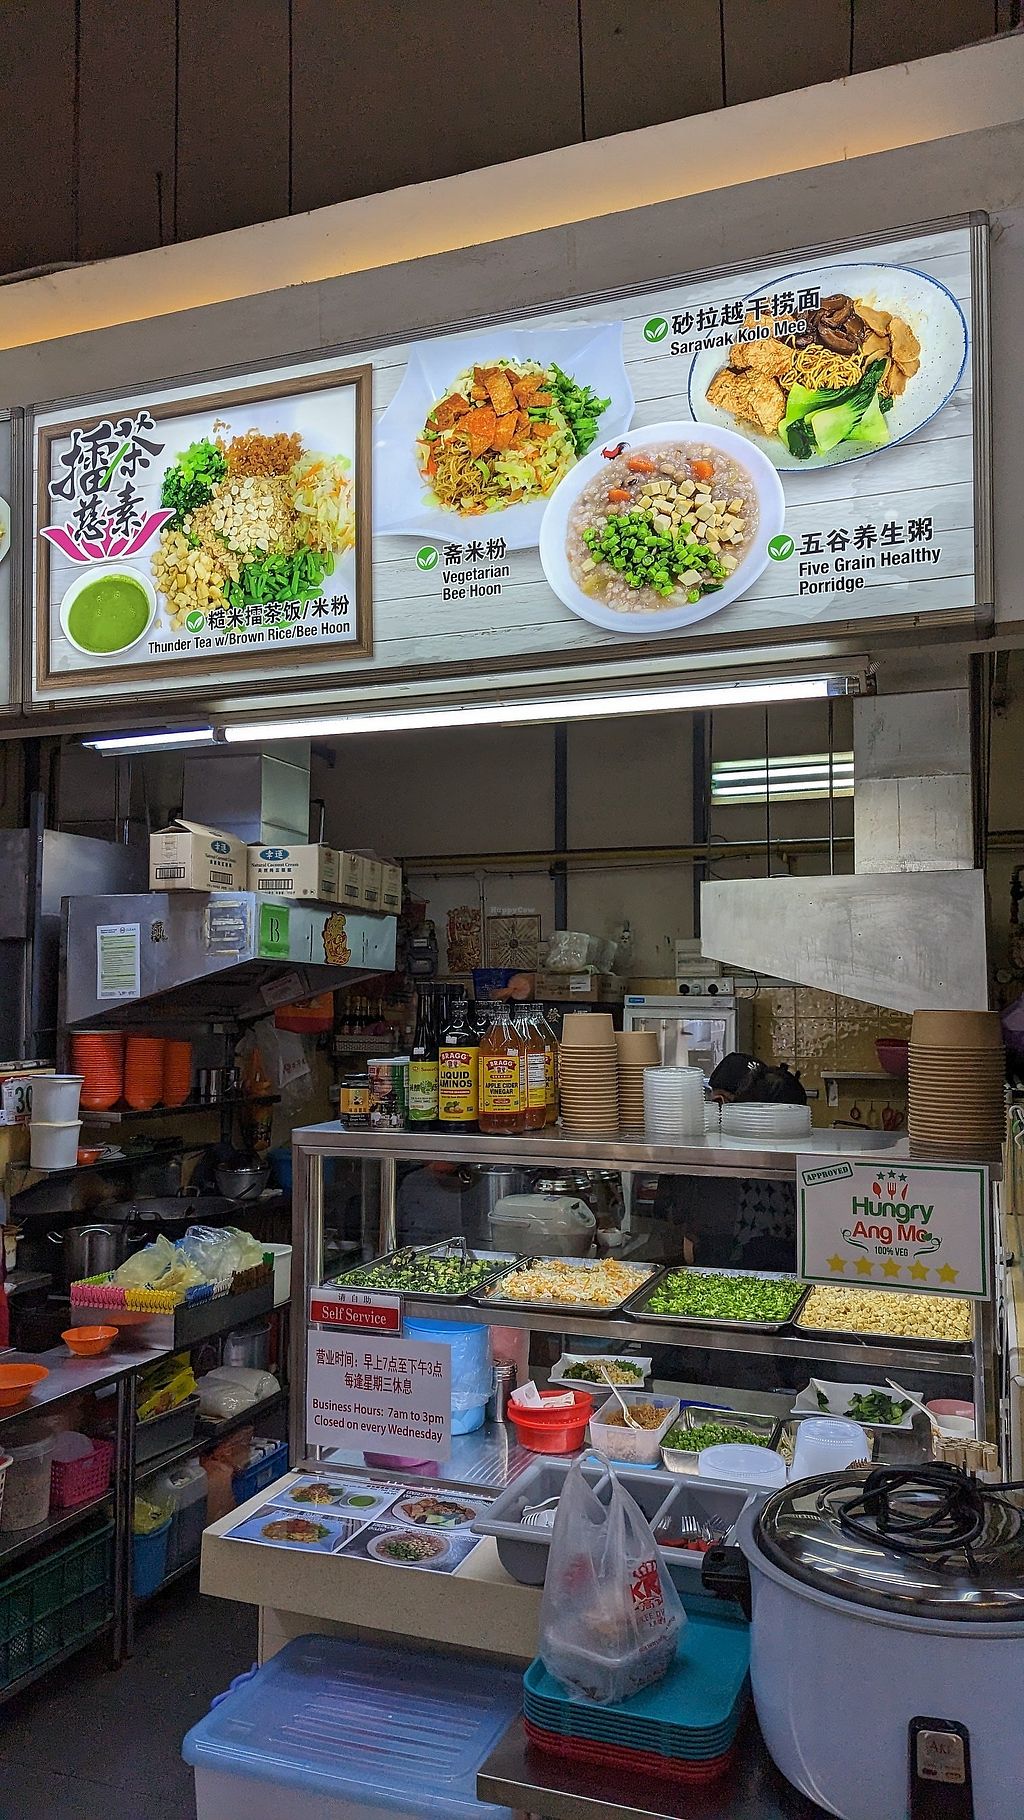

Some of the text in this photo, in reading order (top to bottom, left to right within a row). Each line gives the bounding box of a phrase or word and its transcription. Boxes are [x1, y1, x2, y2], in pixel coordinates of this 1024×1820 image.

[671, 286, 821, 335] 砂拉越干捞面
[670, 320, 806, 356] Sarawak Kolo Mee
[800, 517, 933, 556] 五谷养生粥
[443, 537, 507, 566] 斋米粉
[799, 547, 941, 576] Five Grain Healthy
[442, 564, 510, 585] Vegetarian
[799, 576, 865, 596] Porridge
[442, 582, 502, 601] Bee Hoon
[148, 622, 350, 654] Thunder Tea w/Brown Rice/Bee Hoon
[269, 917, 280, 943] B
[441, 1052, 467, 1060] BRAGG
[806, 1165, 850, 1182] APPROVED
[852, 1196, 935, 1225] Hungry
[852, 1221, 893, 1245] Ang
[874, 1245, 909, 1257] 100% VEG
[322, 1305, 387, 1325] Self Service
[344, 1371, 413, 1395] 每逢星期三休息
[312, 1398, 445, 1426] Business Hours: 7am to 3pm
[314, 1414, 443, 1443] Closed on every Wednesday
